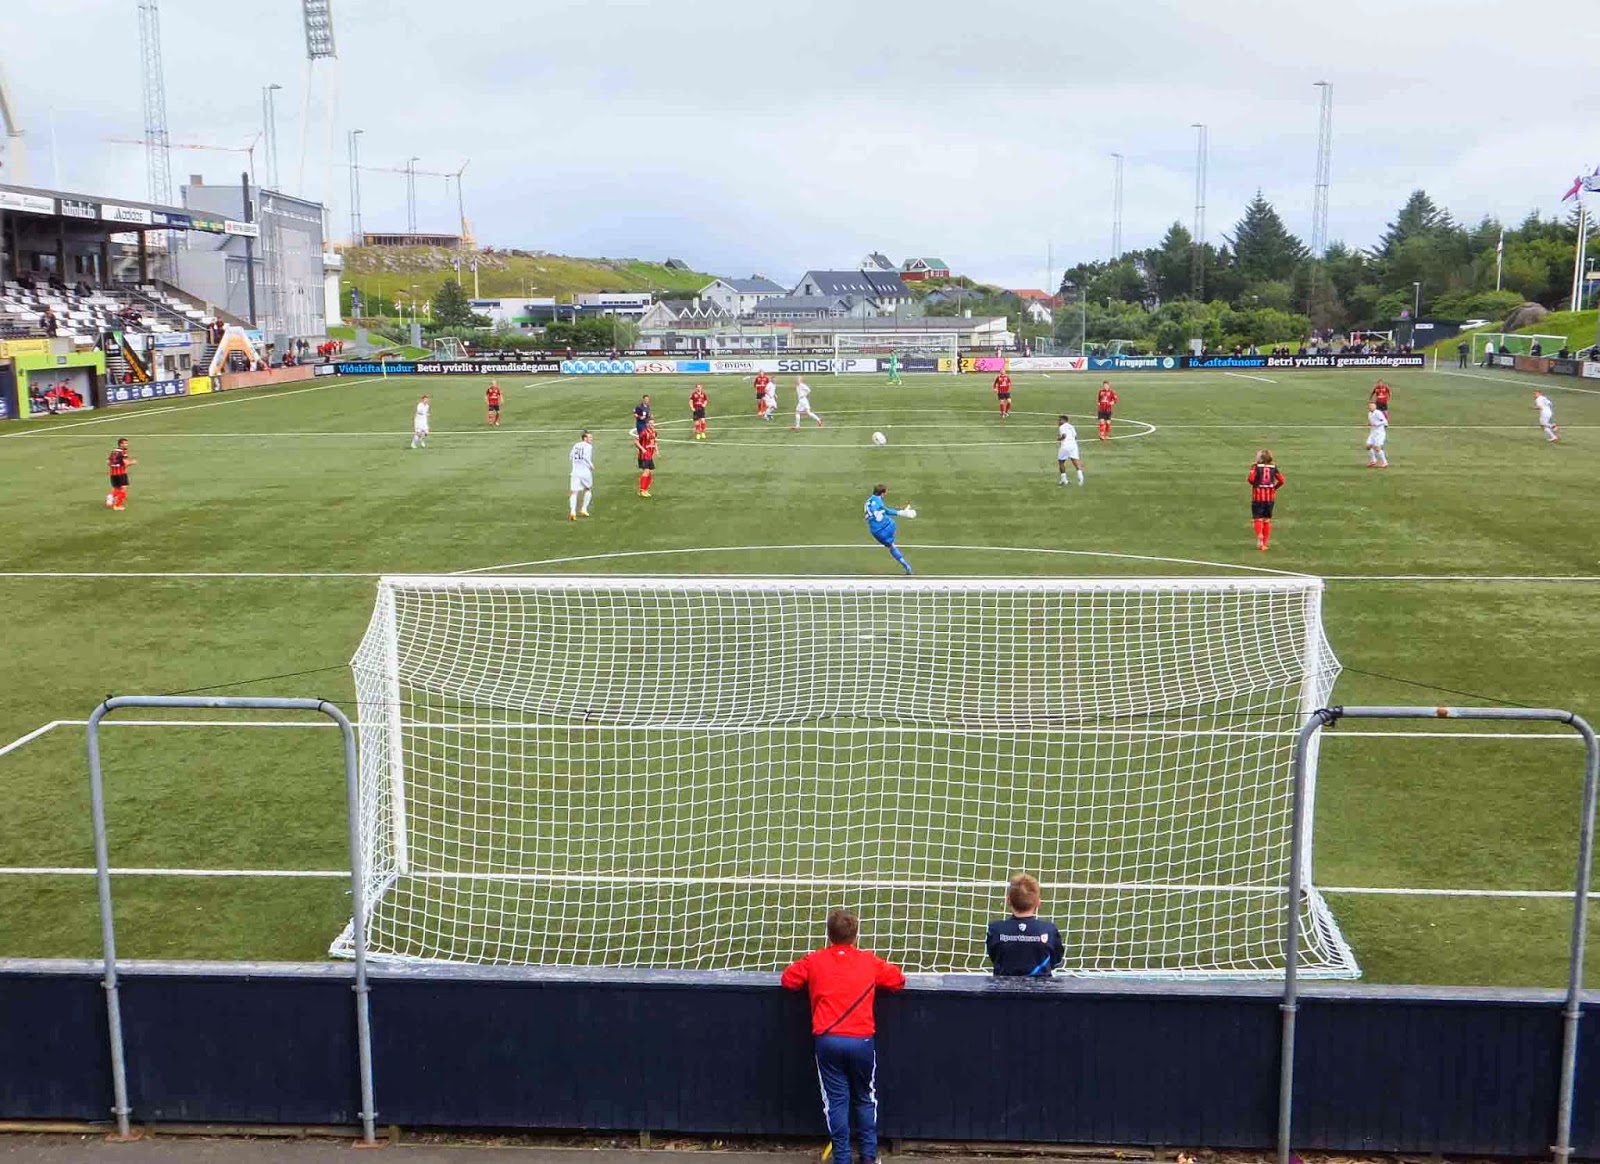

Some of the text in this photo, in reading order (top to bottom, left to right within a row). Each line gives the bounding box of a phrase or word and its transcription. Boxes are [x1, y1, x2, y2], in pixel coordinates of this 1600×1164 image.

[1267, 357, 1293, 366] Betri
[1295, 356, 1329, 368] yvirlit
[1337, 355, 1423, 368] gerandisdegnum
[417, 364, 441, 372] Betri
[442, 363, 473, 373] yvirlit
[481, 363, 559, 373] gerandisdegnum
